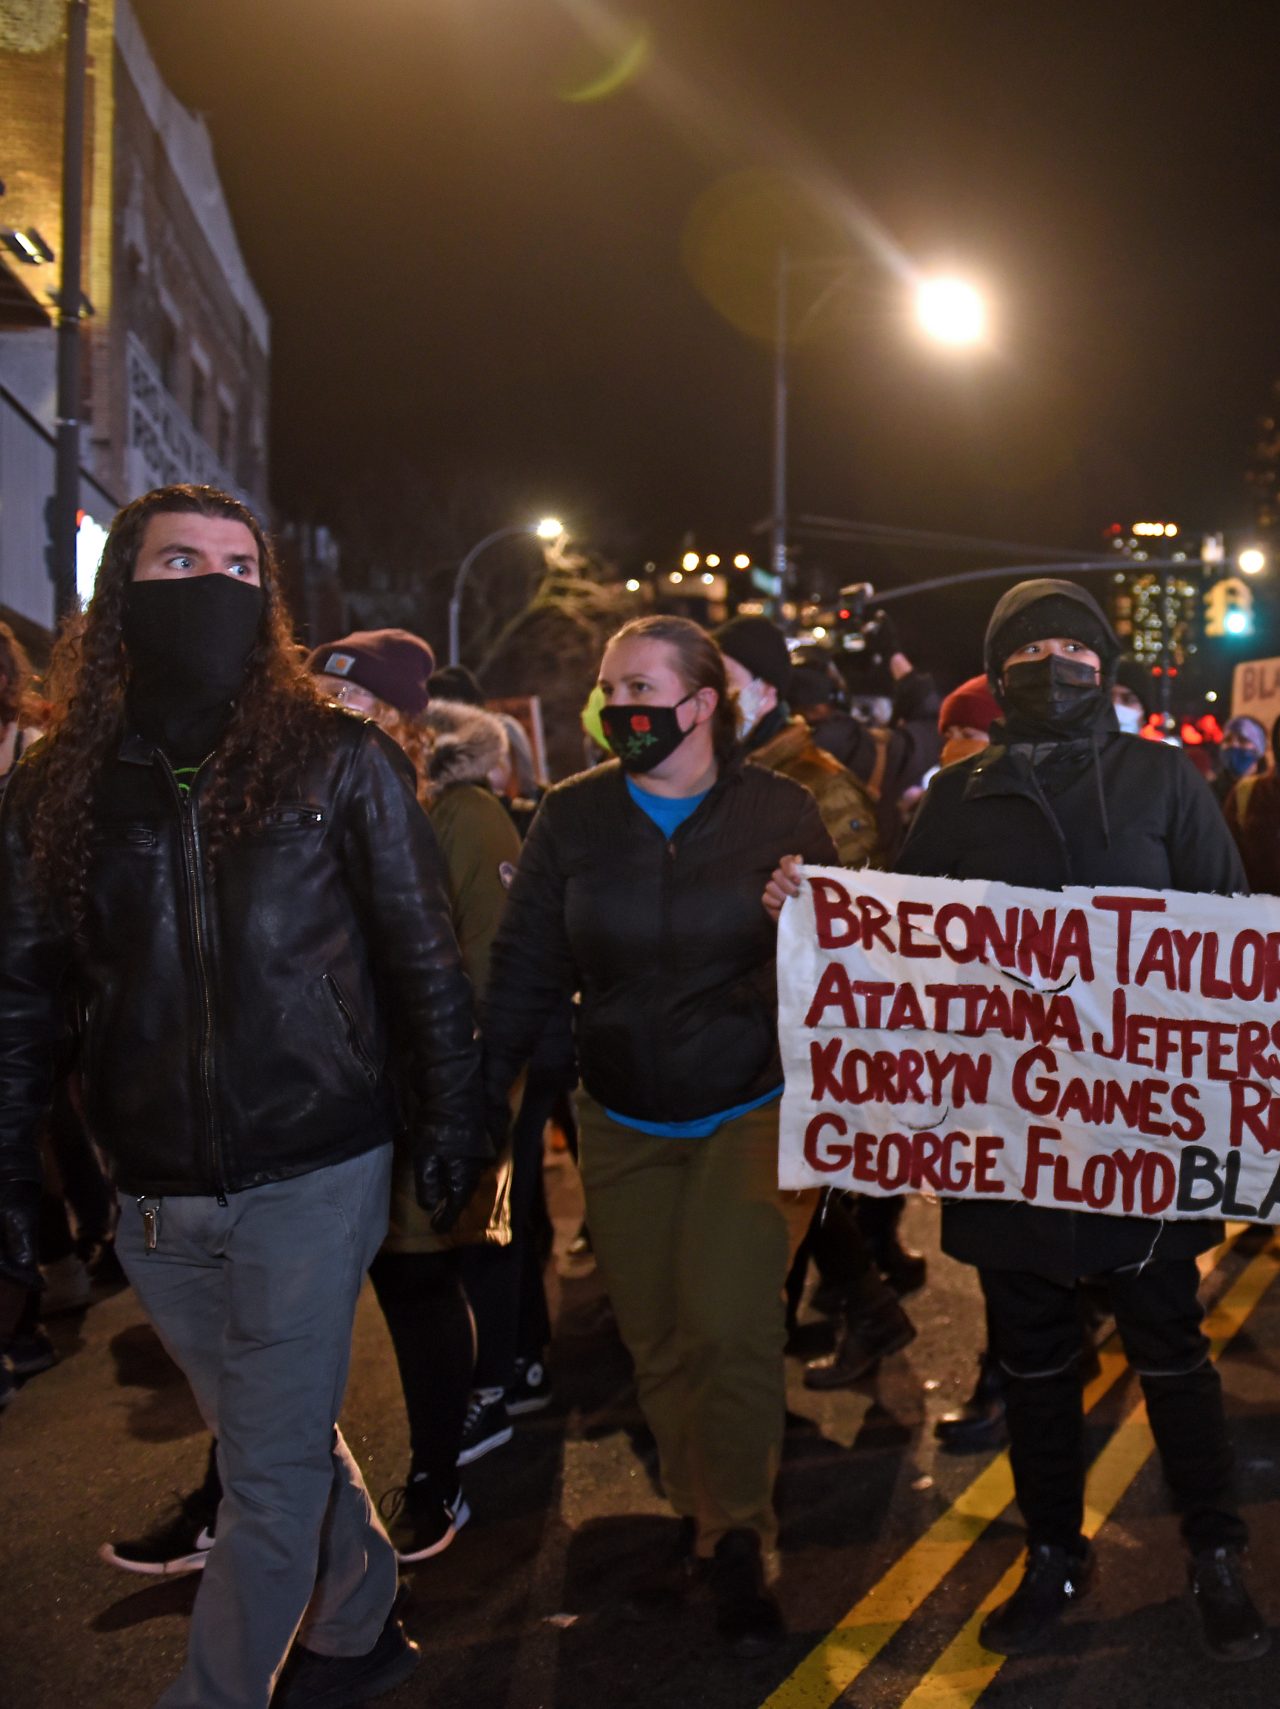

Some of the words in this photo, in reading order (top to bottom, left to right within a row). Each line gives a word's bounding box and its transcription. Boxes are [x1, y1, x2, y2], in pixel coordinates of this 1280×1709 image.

[808, 876, 1094, 983] BREONNA
[810, 1037, 992, 1109] KORRYN
[1012, 1044, 1206, 1142] GAINES
[803, 1112, 1005, 1194] GEORGE
[1021, 1125, 1176, 1215] FLOYD
